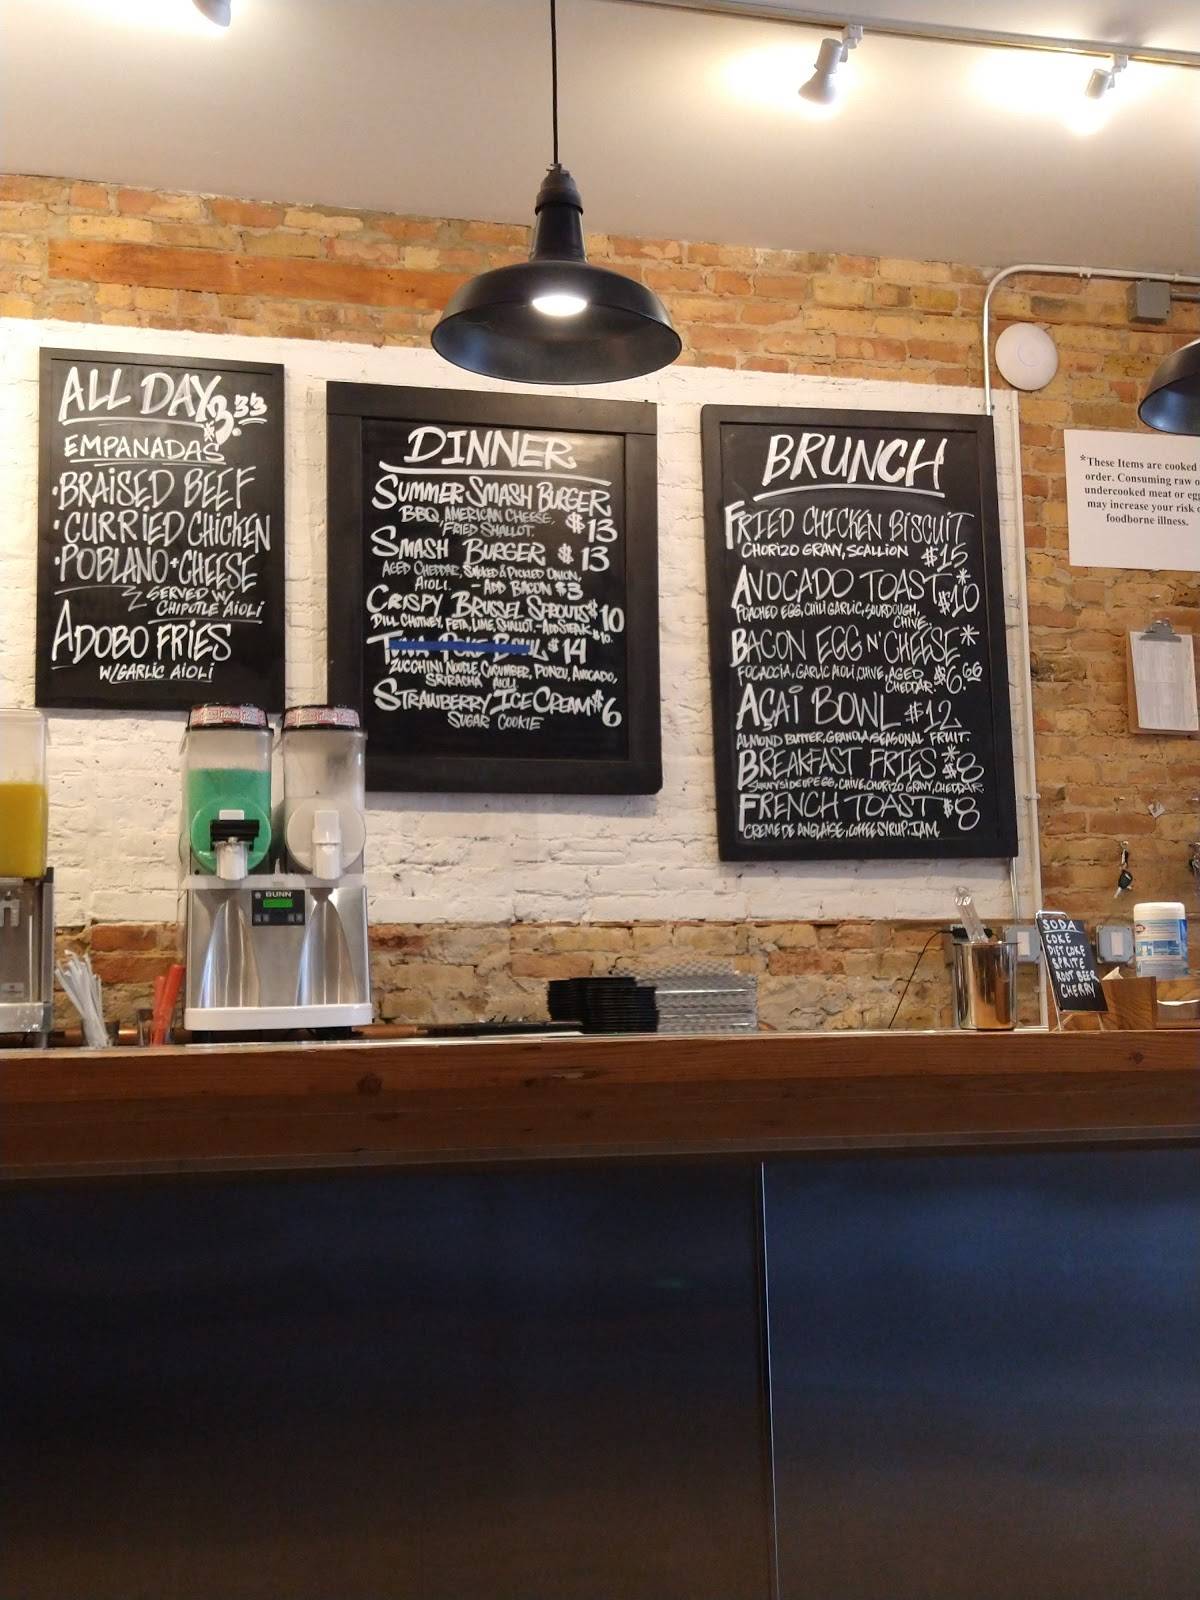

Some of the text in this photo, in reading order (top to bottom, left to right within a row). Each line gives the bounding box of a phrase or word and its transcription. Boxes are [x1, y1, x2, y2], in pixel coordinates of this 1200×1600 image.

[58, 367, 222, 422] ALL DAY
[64, 435, 225, 462] EMPANADAS
[404, 426, 577, 470] DINNER
[761, 433, 948, 489] BRUNCH
[1118, 459, 1144, 470] Items
[1164, 462, 1197, 472] cooked
[184, 466, 256, 511] BEEF
[1085, 472, 1115, 482] order.
[1117, 473, 1172, 487] Consuming
[372, 474, 612, 517] SUMMER SMASH BURGER
[1084, 486, 1146, 498] undercooked
[1149, 489, 1172, 498] meat
[1174, 491, 1186, 499] or
[444, 505, 501, 522] AMERICAN
[1087, 501, 1107, 511] may
[1110, 500, 1149, 511] increase
[1151, 503, 1173, 513] your
[1176, 503, 1194, 513] risk
[442, 521, 479, 537] FRIED
[565, 511, 618, 543] $13
[724, 501, 795, 550] FRIED
[803, 506, 882, 541] CHICKEN
[1106, 513, 1189, 526] foodborne illness.
[370, 525, 448, 560] SMASH
[462, 538, 546, 566] BURGER
[60, 544, 168, 583] POBLANO
[179, 549, 257, 592] CHEESE
[382, 561, 411, 577] AGED
[507, 566, 545, 580] PICKLED
[147, 586, 207, 600] SERVED
[484, 579, 507, 595] ADD
[510, 580, 552, 598] BACON
[555, 582, 584, 600] $3
[731, 565, 855, 608] AVOCADO
[156, 601, 219, 618] CHIPOTLE
[366, 584, 443, 618] CRISPY
[450, 591, 524, 620] BRUSSEL
[526, 595, 590, 623] SPROUTS
[370, 613, 400, 629] DILL
[735, 604, 778, 624] POACHED
[52, 599, 149, 664] ADOBO
[730, 628, 806, 667] BACON
[816, 624, 863, 664] EGG
[389, 657, 443, 674] ZUCCHINI
[425, 673, 483, 688] SRIRACHA
[373, 678, 492, 714] STRAWBERRY
[490, 687, 533, 715] ICE
[533, 686, 592, 716] CREAM
[812, 686, 901, 731] BOWL
[904, 700, 962, 733] $12
[448, 711, 544, 730] SUGAR COOKIE
[736, 732, 783, 750] ALMOND
[738, 747, 862, 790] BREAKFAST
[870, 747, 937, 782] FRIES
[739, 791, 839, 832] FRENCH
[843, 793, 945, 821] TOAST
[744, 823, 781, 840] CREME
[1042, 919, 1077, 931] SODA
[1046, 932, 1072, 944] COKE
[1047, 945, 1086, 957] DIET COKE
[1052, 958, 1085, 970] SPRITE
[1056, 970, 1100, 982] ROOT BEER
[1060, 982, 1096, 998] CHERRY
